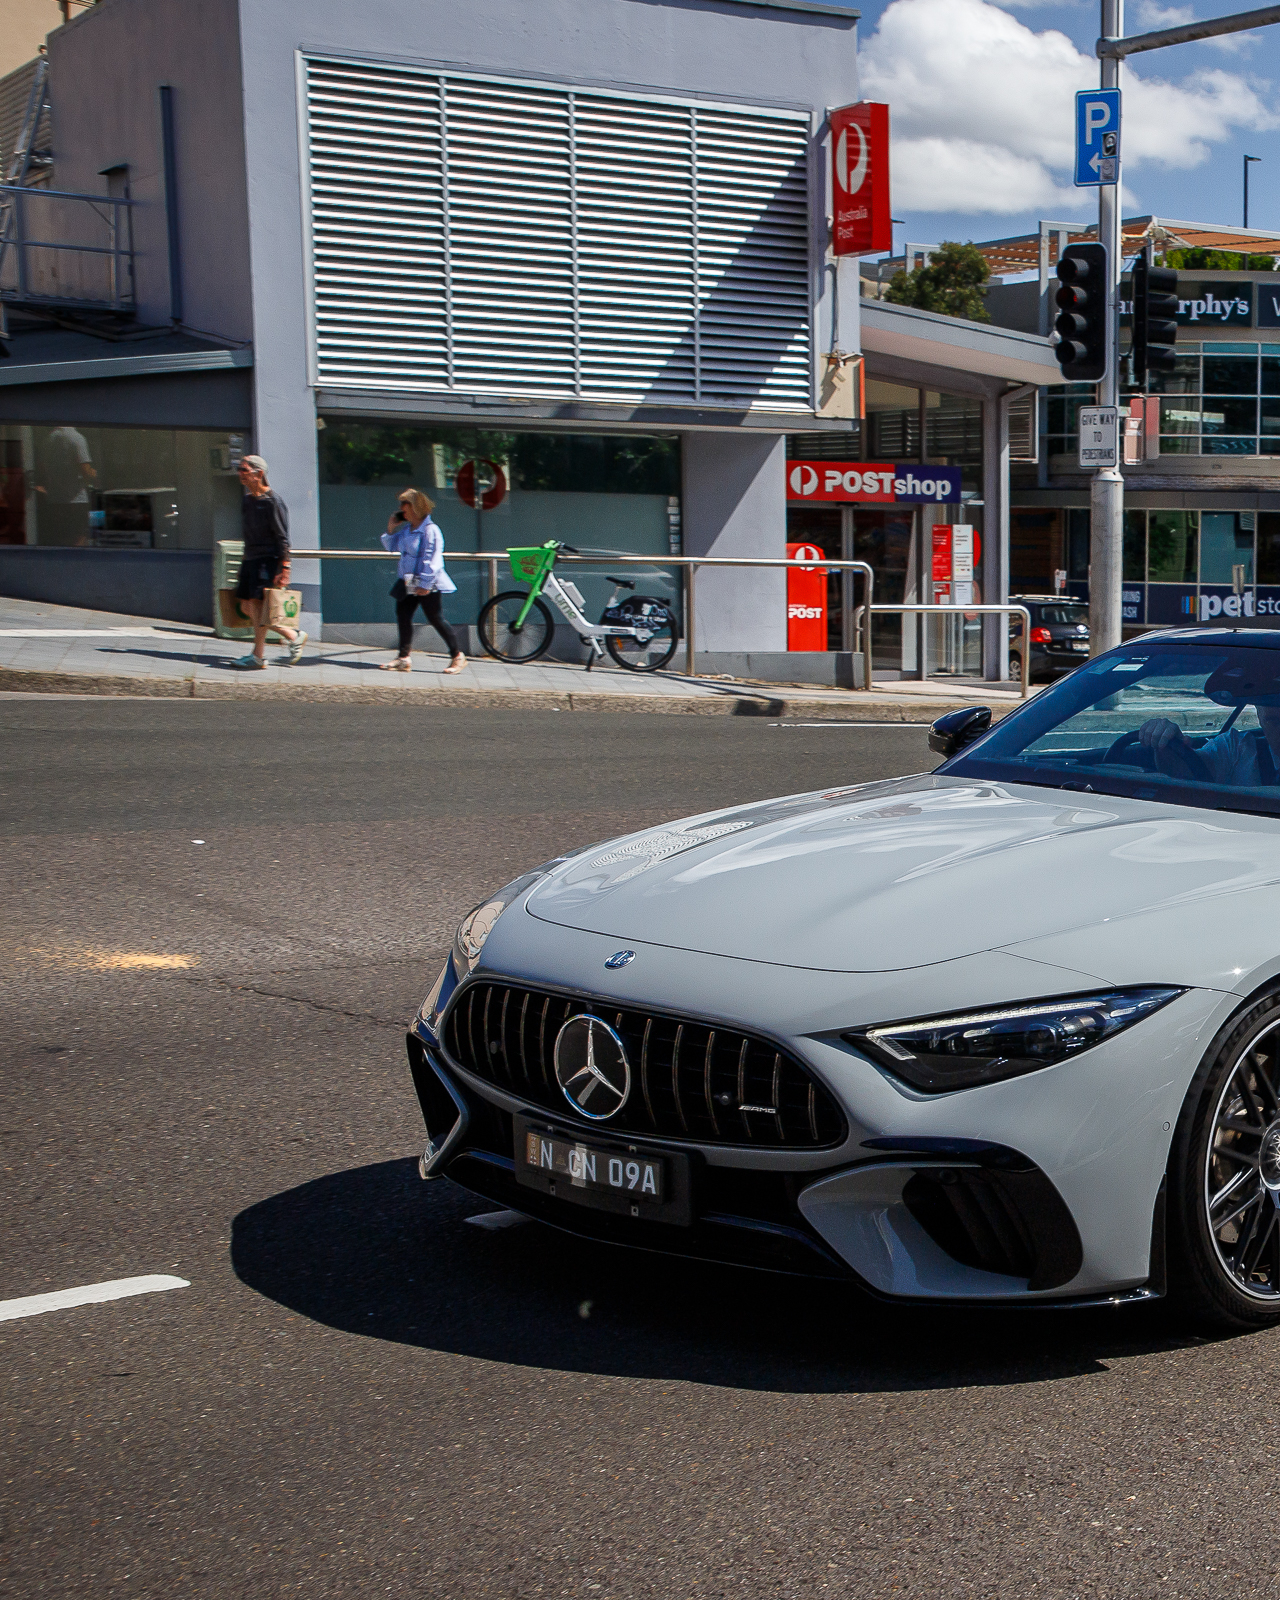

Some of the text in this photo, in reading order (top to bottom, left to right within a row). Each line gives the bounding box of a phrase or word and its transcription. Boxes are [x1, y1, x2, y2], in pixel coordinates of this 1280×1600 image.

[1085, 101, 1111, 145] P
[838, 225, 854, 239] Post
[1175, 293, 1249, 321] rphy's
[1082, 413, 1116, 425] GIVE WAY
[1093, 430, 1103, 443] TO
[788, 607, 823, 619] POST
[750, 1106, 776, 1114] AMG
[541, 1140, 657, 1194] N CN 09A
